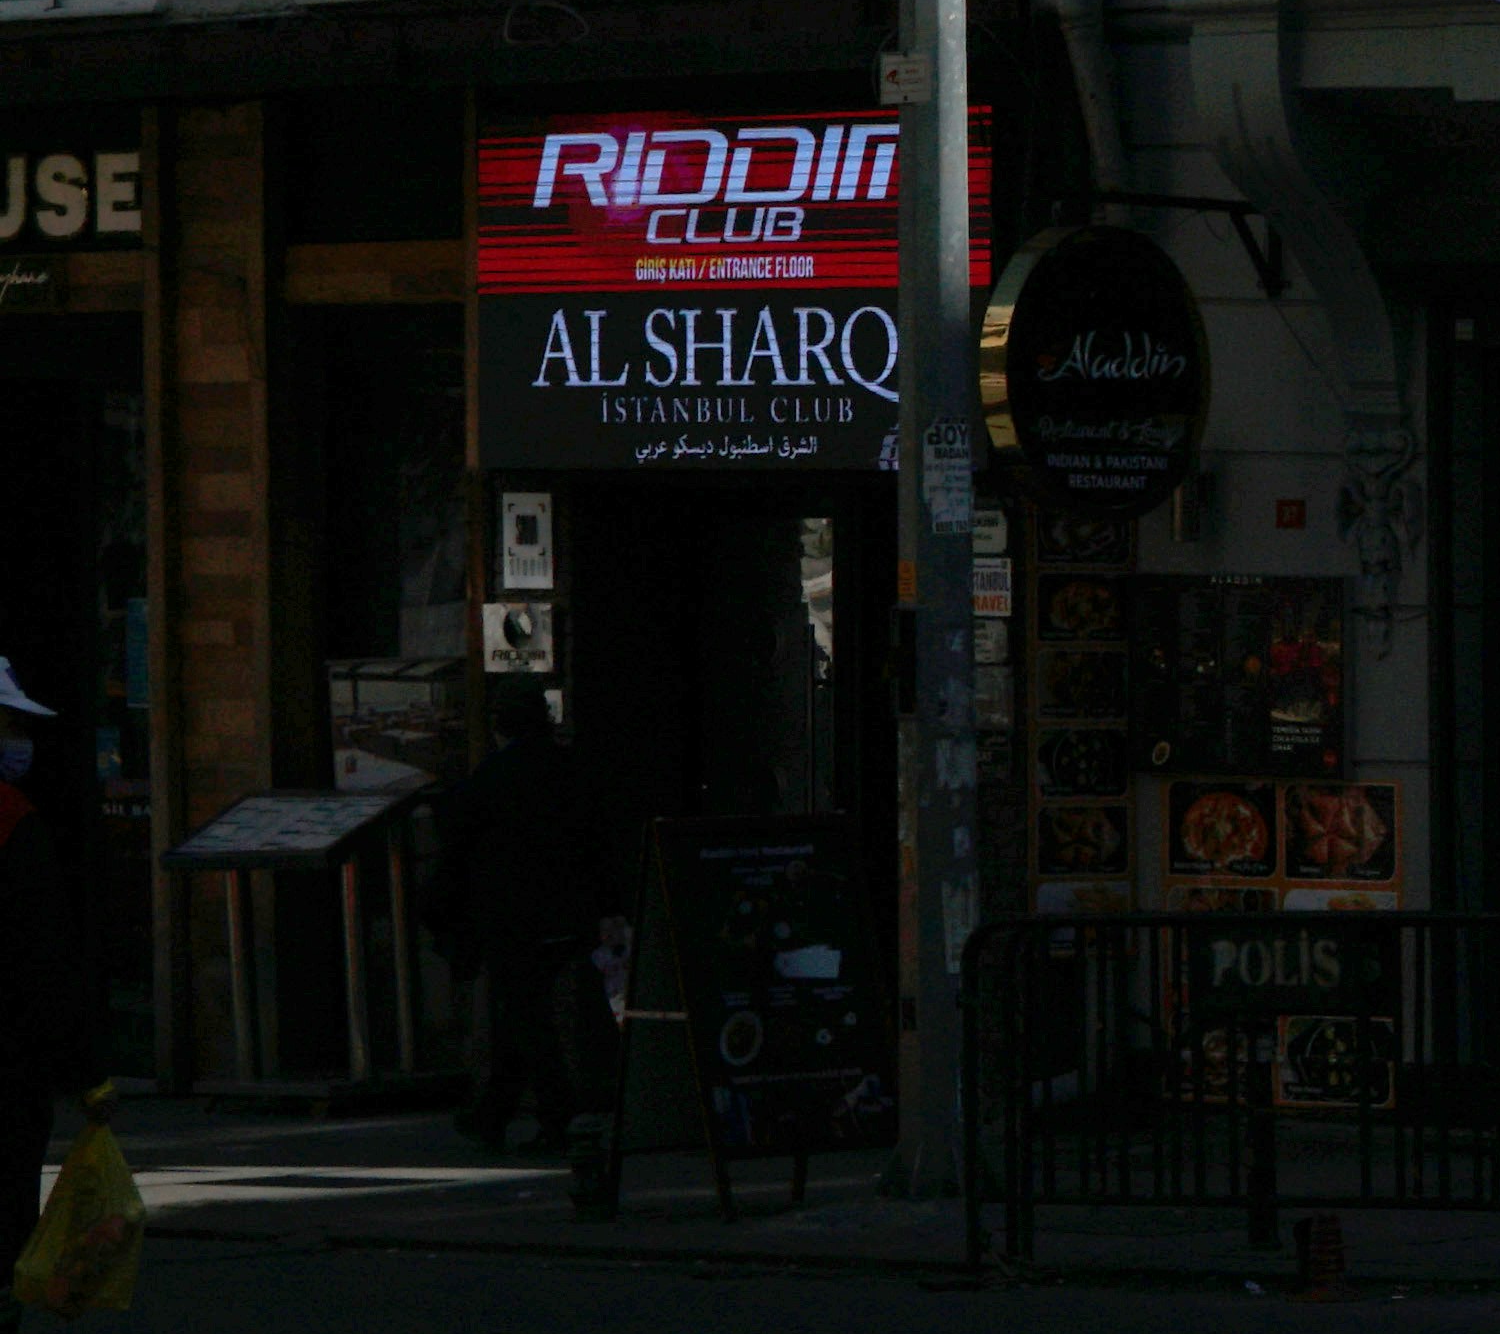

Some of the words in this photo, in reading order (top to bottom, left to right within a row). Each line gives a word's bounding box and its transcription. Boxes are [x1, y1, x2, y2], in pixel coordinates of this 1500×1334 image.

[646, 207, 808, 245] CLUB
[636, 258, 667, 283] GİRİŞ
[708, 256, 772, 279] ENTRANCE
[774, 255, 815, 278] FLOOR
[531, 308, 630, 387] AL
[644, 304, 900, 404] SHARQ
[1037, 329, 1188, 382] Aladdin
[601, 391, 755, 424] İSTANBUL
[770, 396, 855, 424] CLUB
[1068, 473, 1149, 491] RESTAURANT
[1208, 926, 1341, 988] POLİS
